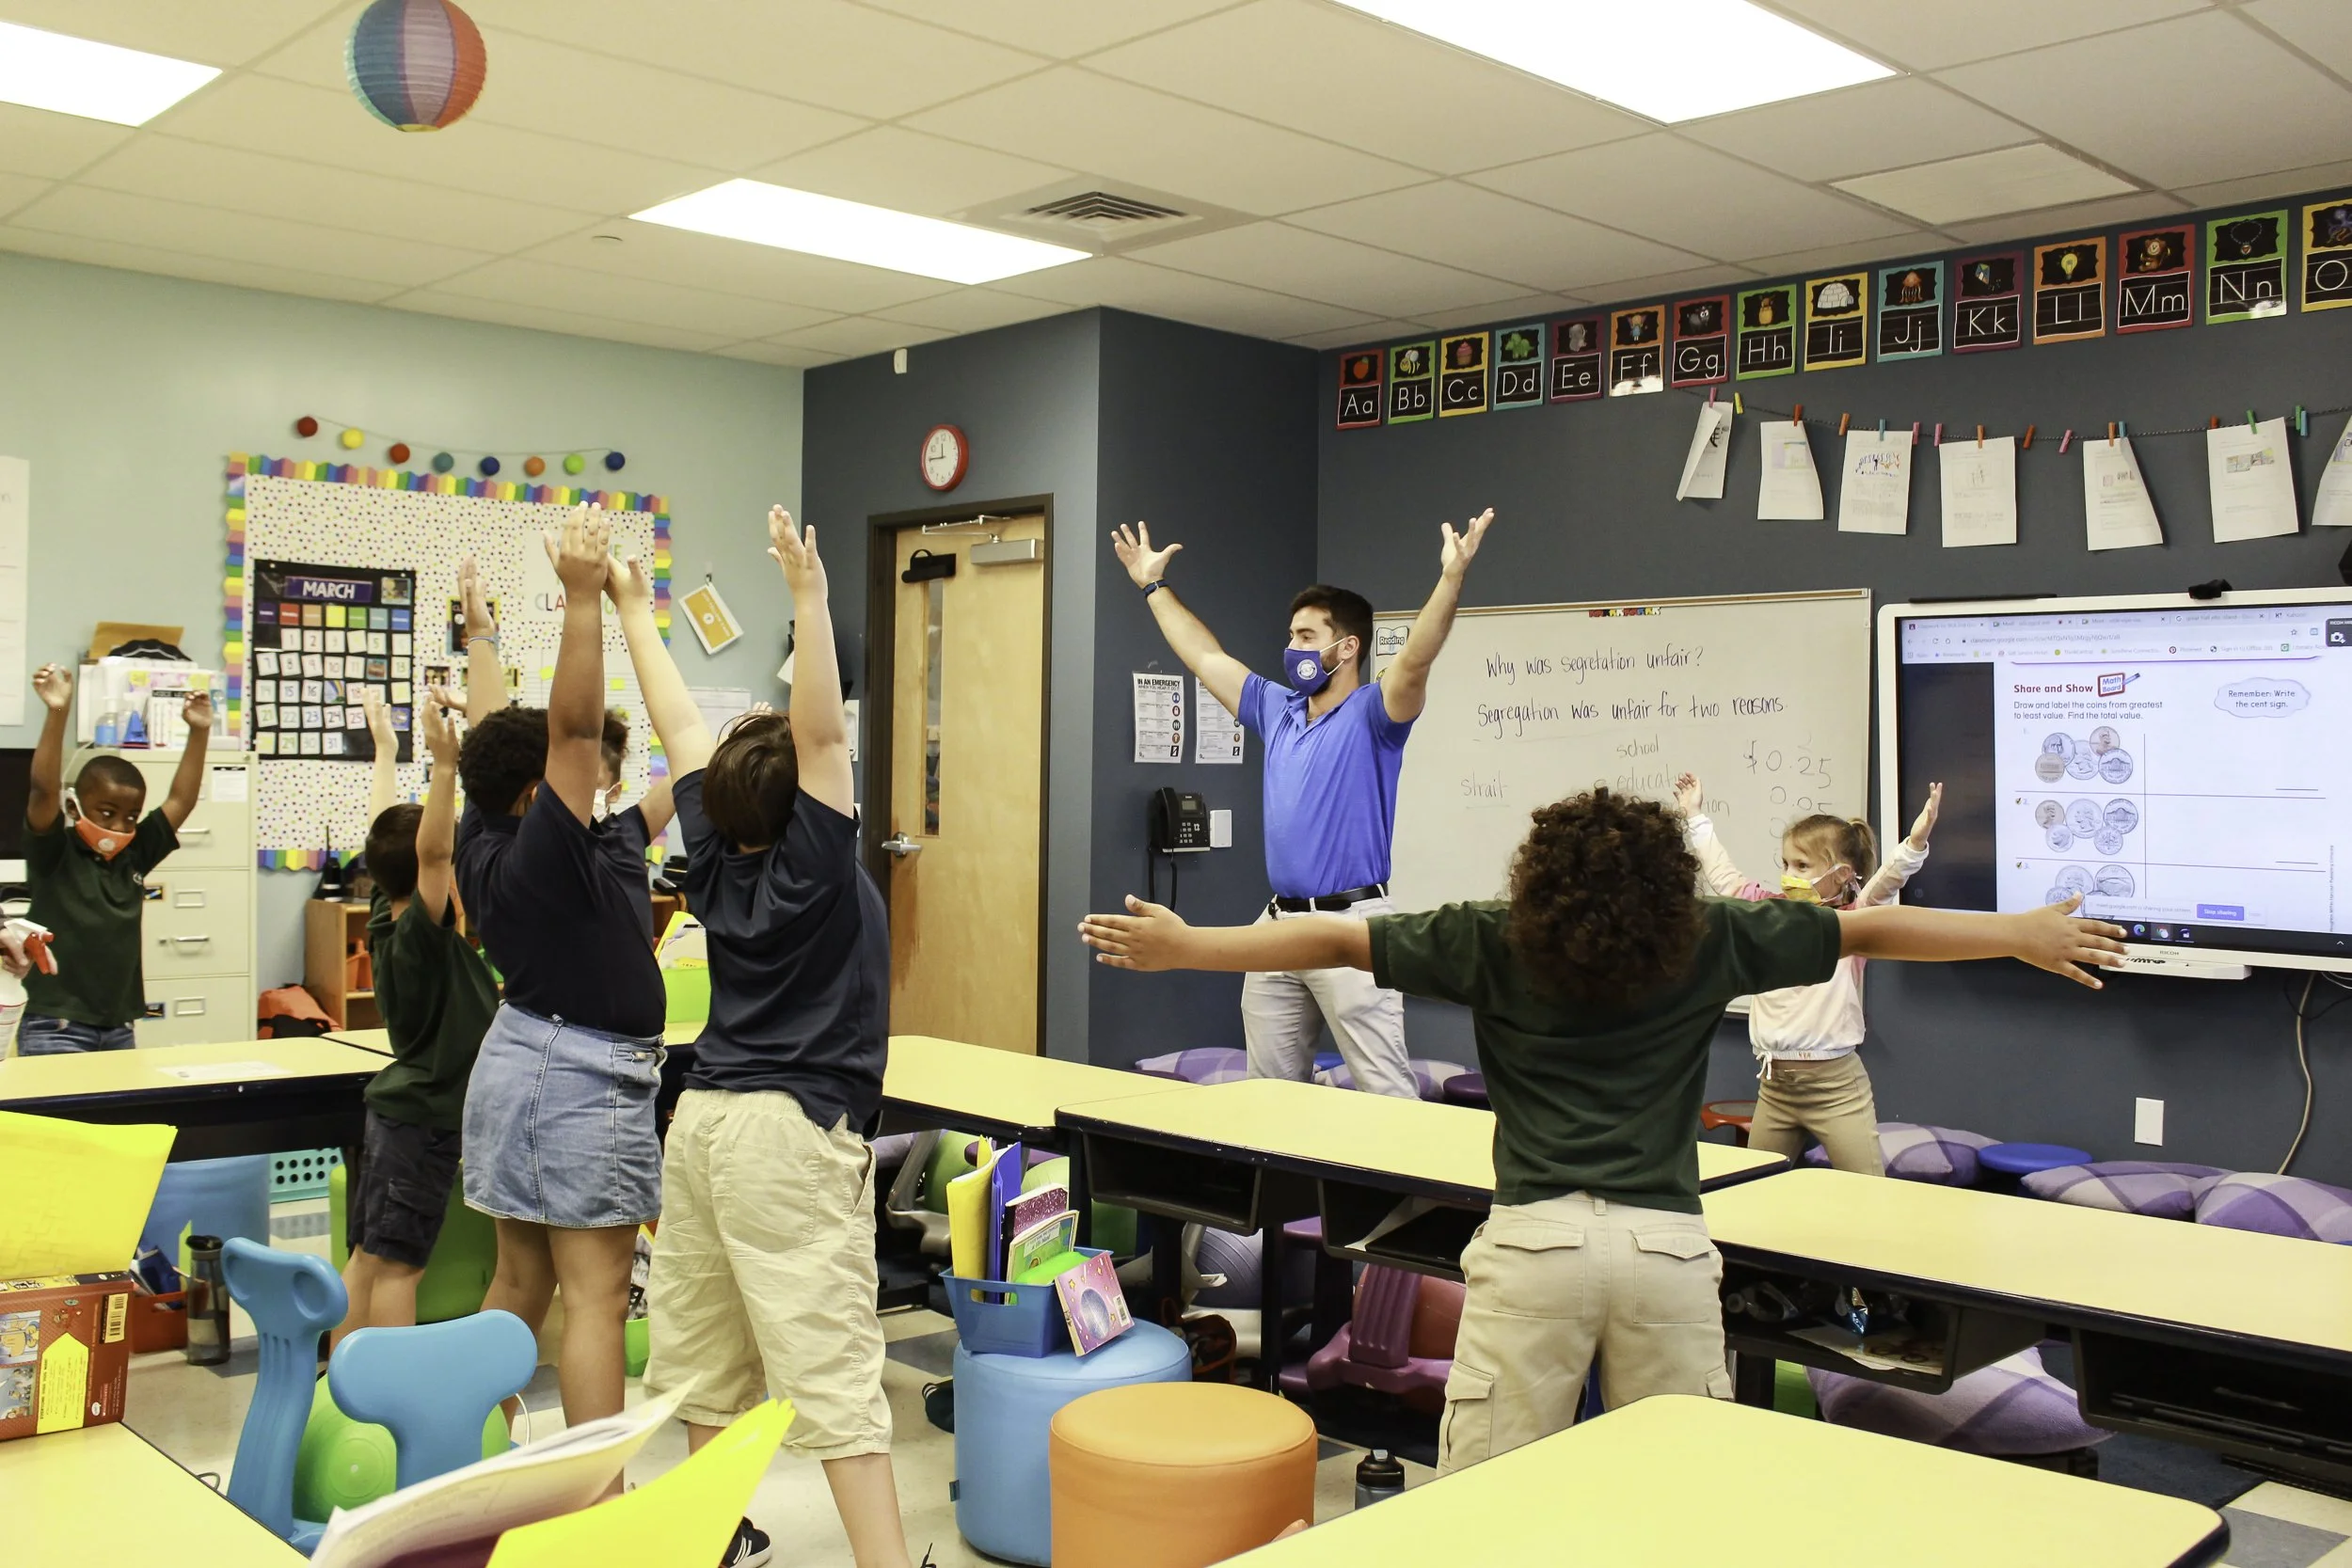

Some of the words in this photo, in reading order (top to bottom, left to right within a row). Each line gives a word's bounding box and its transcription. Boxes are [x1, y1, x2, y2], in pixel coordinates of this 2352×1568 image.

[2219, 270, 2272, 304] Nn
[2054, 293, 2083, 325] Ll
[2124, 284, 2185, 317] Mm
[1968, 307, 2007, 337] Kk
[1828, 324, 1844, 354] Ii
[1894, 316, 1923, 353] Jj
[1747, 336, 1787, 363] Hh
[1678, 346, 1720, 380] Gg
[1502, 371, 1536, 396] Dd
[1561, 363, 1592, 388] Ee
[1397, 388, 1425, 410] Bb
[1448, 380, 1478, 404] Cc
[1343, 395, 1374, 417] Aa
[302, 580, 356, 599] MARCH
[310, 635, 317, 646] 2
[1379, 636, 1405, 645] Reading
[1486, 652, 1516, 686] Why
[1526, 656, 1552, 675] was
[1646, 642, 1705, 668] unfair?
[284, 686, 294, 698] 15
[307, 686, 317, 697] 16
[2013, 684, 2042, 693] Share
[2044, 684, 2062, 693] and
[2065, 684, 2093, 693] Show
[2102, 676, 2122, 686] Math
[2102, 685, 2122, 693] Board
[307, 710, 319, 722] 23
[327, 710, 342, 723] 24
[350, 712, 362, 723] 25
[1478, 697, 1559, 739] Segregation
[1572, 700, 1599, 720] was
[1612, 698, 1653, 721] unfair
[1658, 690, 1679, 718] for
[1689, 694, 1720, 719] two
[2013, 701, 2034, 709] Draw
[2035, 701, 2050, 709] and
[2051, 701, 2071, 709] label
[2072, 701, 2085, 709] the
[2086, 701, 2107, 709] coins
[2108, 701, 2128, 709] from
[2128, 701, 2163, 710] greatest
[2013, 711, 2022, 720] to
[2023, 711, 2042, 720] least
[2042, 711, 2066, 720] value.
[2068, 711, 2085, 720] Find
[2086, 711, 2099, 720] the
[2100, 711, 2118, 720] total
[2119, 711, 2143, 720] value.
[2269, 701, 2288, 709] sign.
[1616, 734, 1660, 759] school
